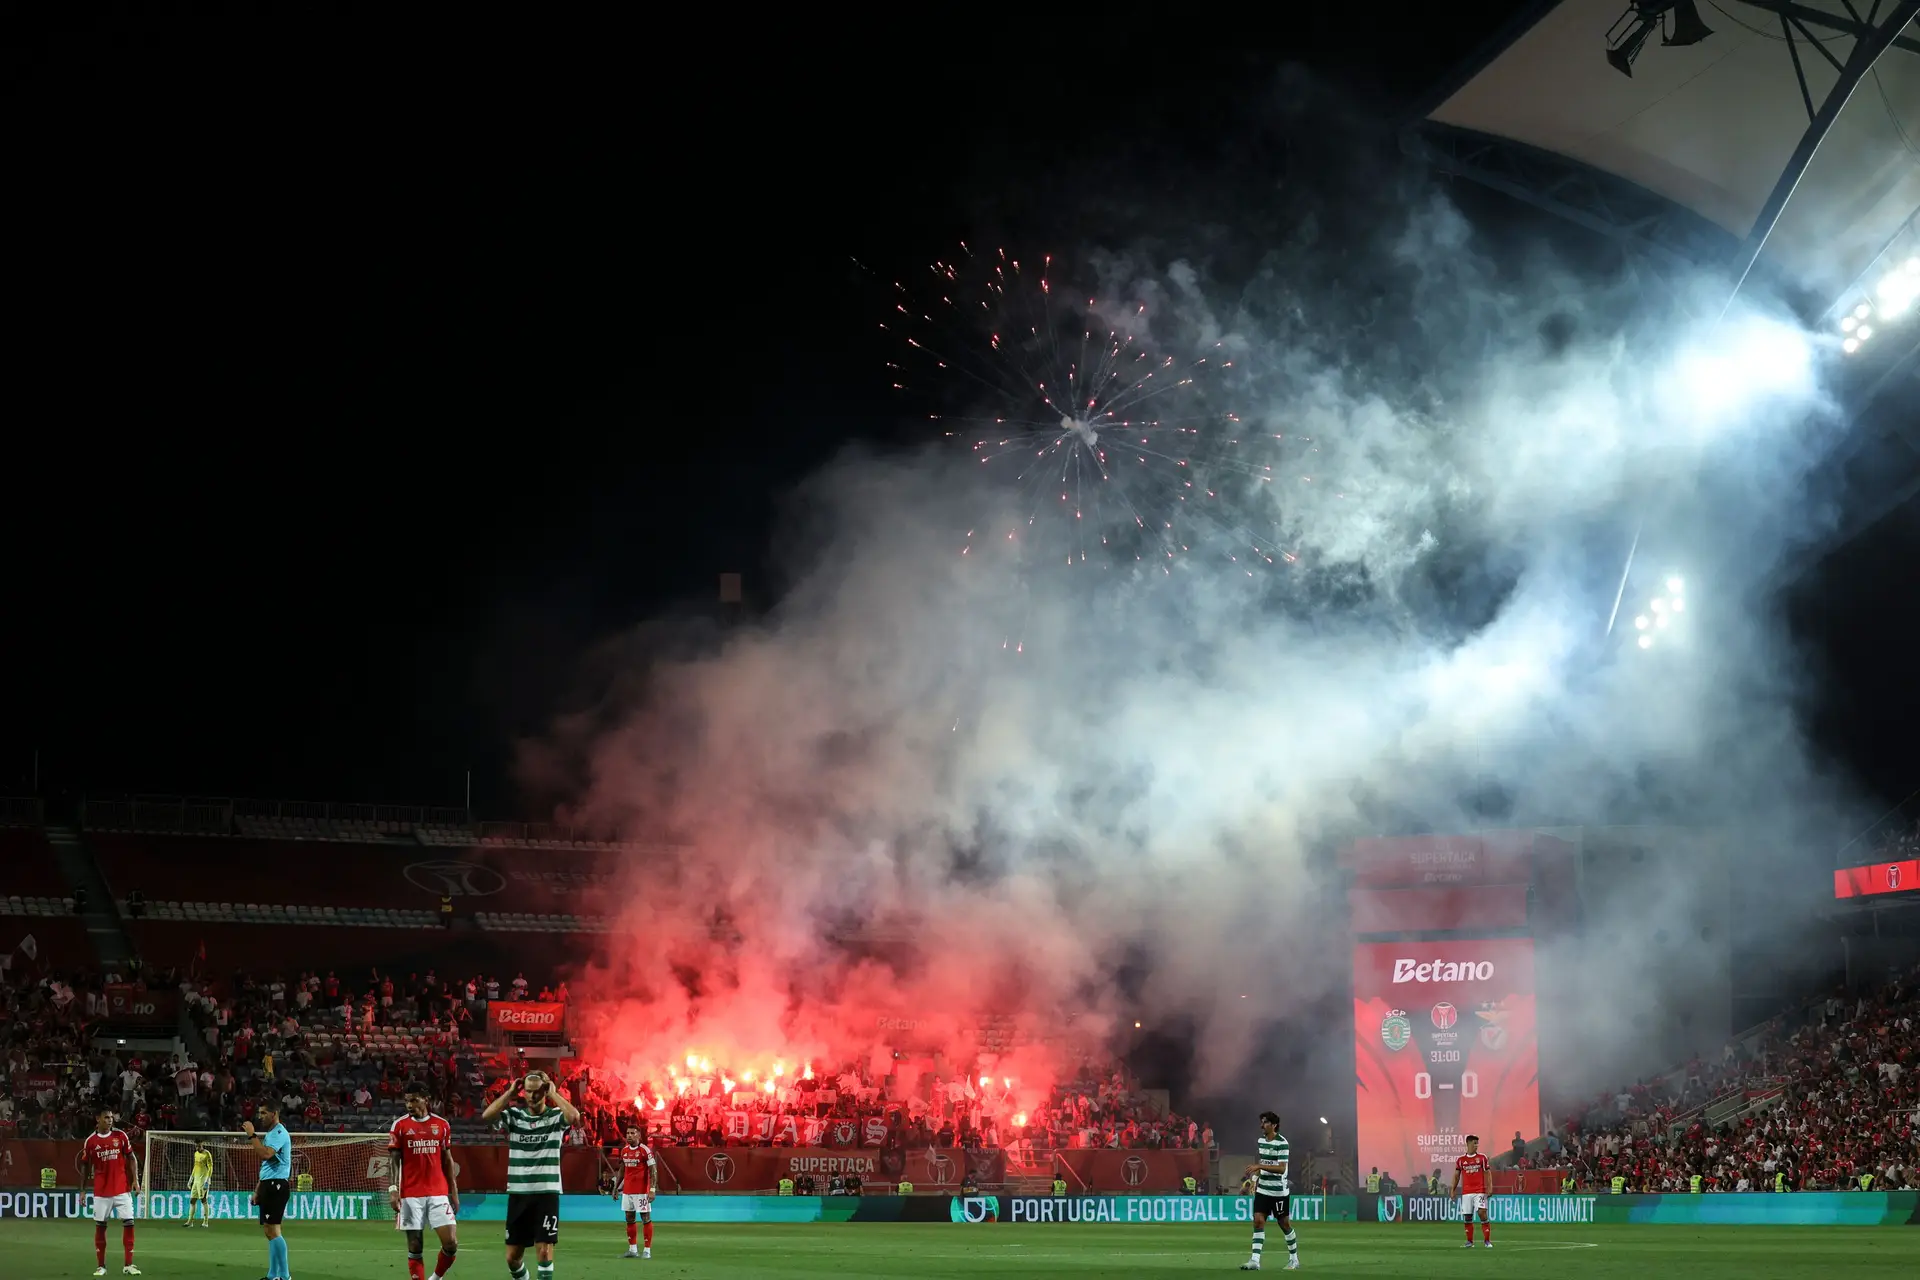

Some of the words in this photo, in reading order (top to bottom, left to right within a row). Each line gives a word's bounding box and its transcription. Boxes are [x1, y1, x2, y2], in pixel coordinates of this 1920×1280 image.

[1393, 959, 1494, 983] Betano
[499, 1009, 555, 1024] Betano
[1385, 1009, 1406, 1018] SCP
[1430, 1050, 1460, 1062] 31:00
[1415, 1072, 1432, 1099] 0
[1461, 1071, 1478, 1098] 0
[407, 1138, 440, 1148] Emirates
[518, 1134, 549, 1143] Betano
[1431, 1154, 1459, 1163] Betan
[283, 1194, 372, 1219] UMMIT
[1011, 1198, 1120, 1222] PORTUGAL
[1127, 1198, 1229, 1221] FOOTBALL
[1275, 1201, 1284, 1211] 17
[1538, 1197, 1597, 1222] SUMMIT
[542, 1215, 558, 1231] 42
